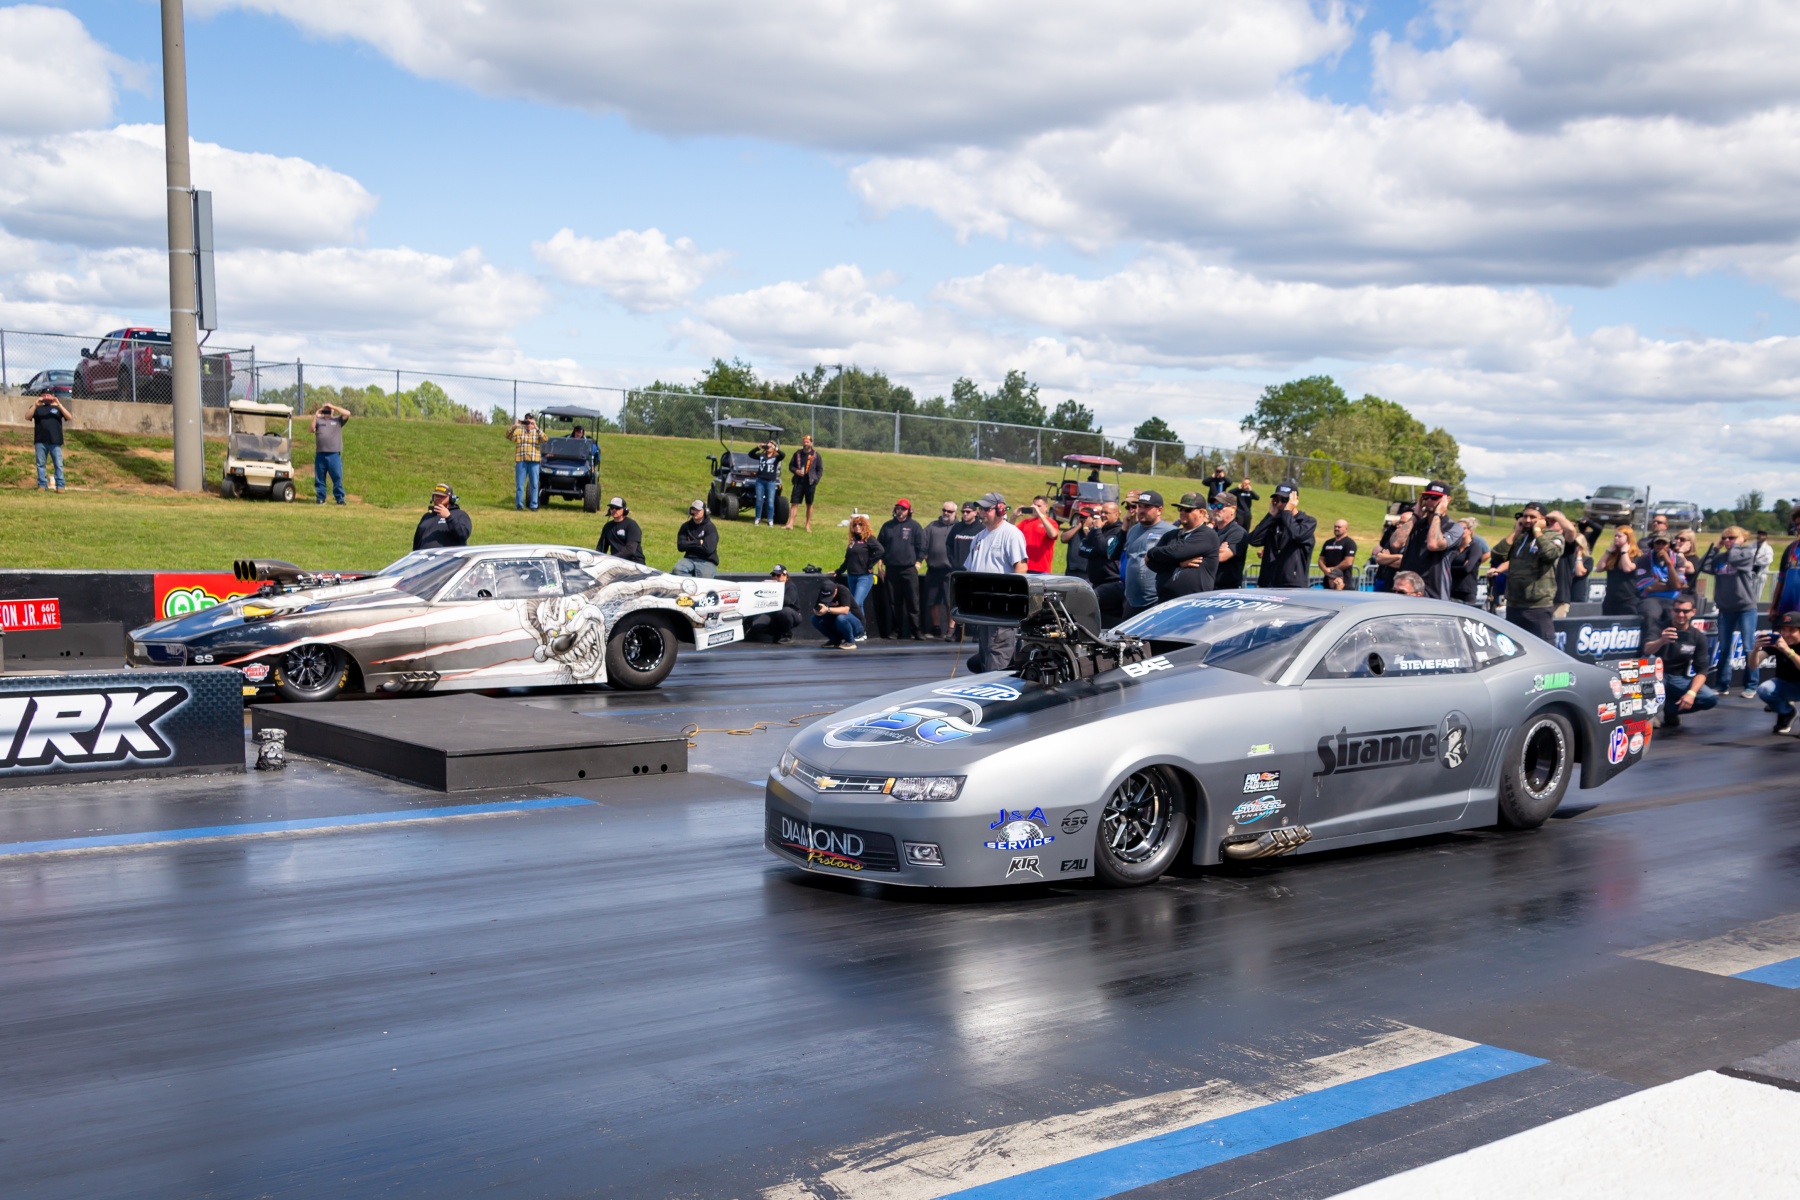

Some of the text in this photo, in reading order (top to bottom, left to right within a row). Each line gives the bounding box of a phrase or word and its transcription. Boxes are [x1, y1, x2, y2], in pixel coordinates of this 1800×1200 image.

[41, 603, 56, 613] 660
[1182, 598, 1284, 612] SHADOW
[0, 604, 40, 628] ON JR.
[42, 613, 57, 625] AVE
[194, 654, 214, 664] SS
[1400, 658, 1461, 670] STEVIE FAST
[0, 691, 178, 760] RK
[1313, 726, 1438, 777] Strange
[1246, 773, 1261, 783] PRO
[1061, 816, 1089, 827] RSG
[782, 816, 864, 857] DIAMOND
[986, 836, 1052, 850] SERVICE
[807, 850, 864, 872] Pistons
